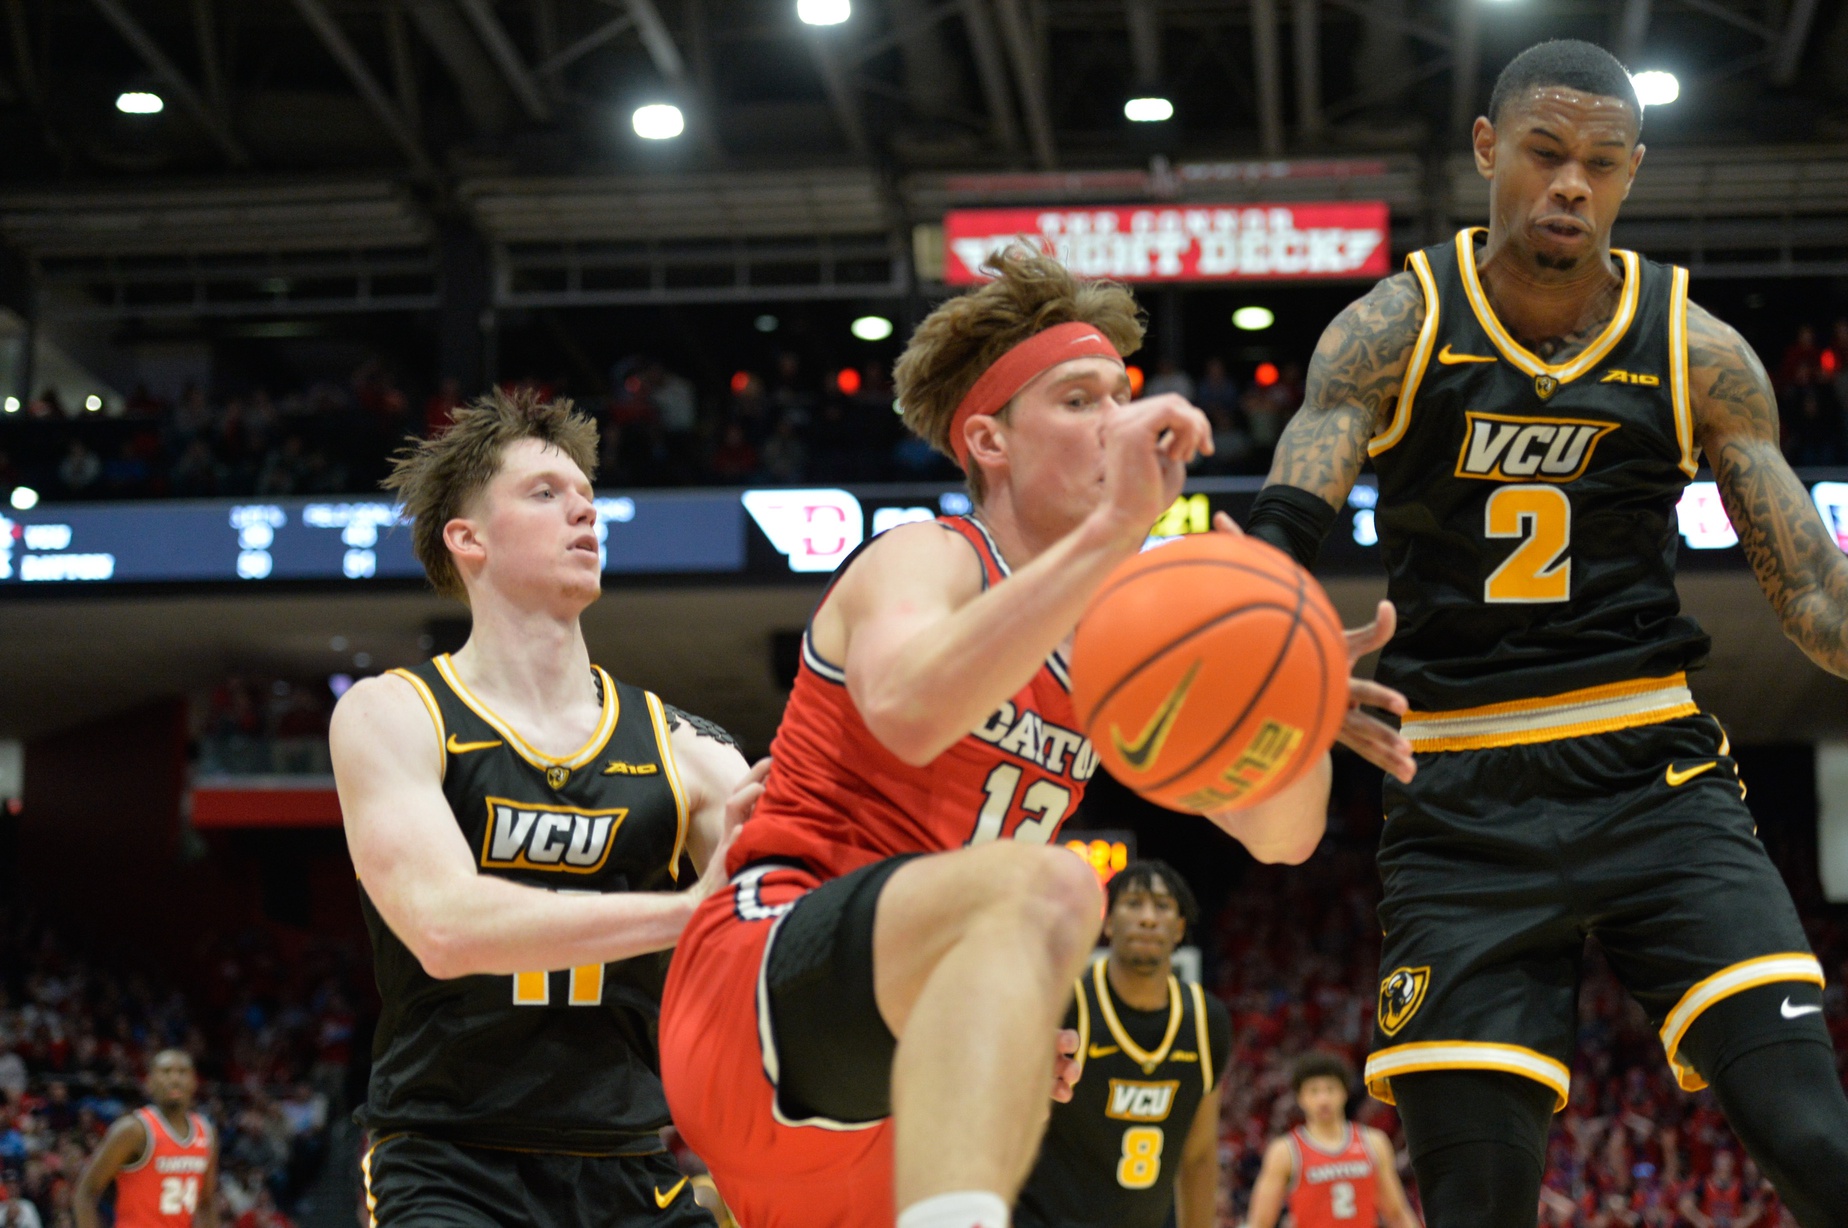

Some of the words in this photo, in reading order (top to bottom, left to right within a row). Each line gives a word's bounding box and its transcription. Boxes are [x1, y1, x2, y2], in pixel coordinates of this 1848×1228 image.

[1198, 228, 1345, 274] DECK
[1601, 369, 1660, 387] A10
[1462, 417, 1603, 478] VCU
[1484, 483, 1571, 603] 2
[489, 804, 614, 868] VCU
[1110, 1083, 1173, 1117] VCU
[1116, 1125, 1165, 1190] 8
[160, 1176, 199, 1215] 24
[1331, 1182, 1357, 1219] 2
